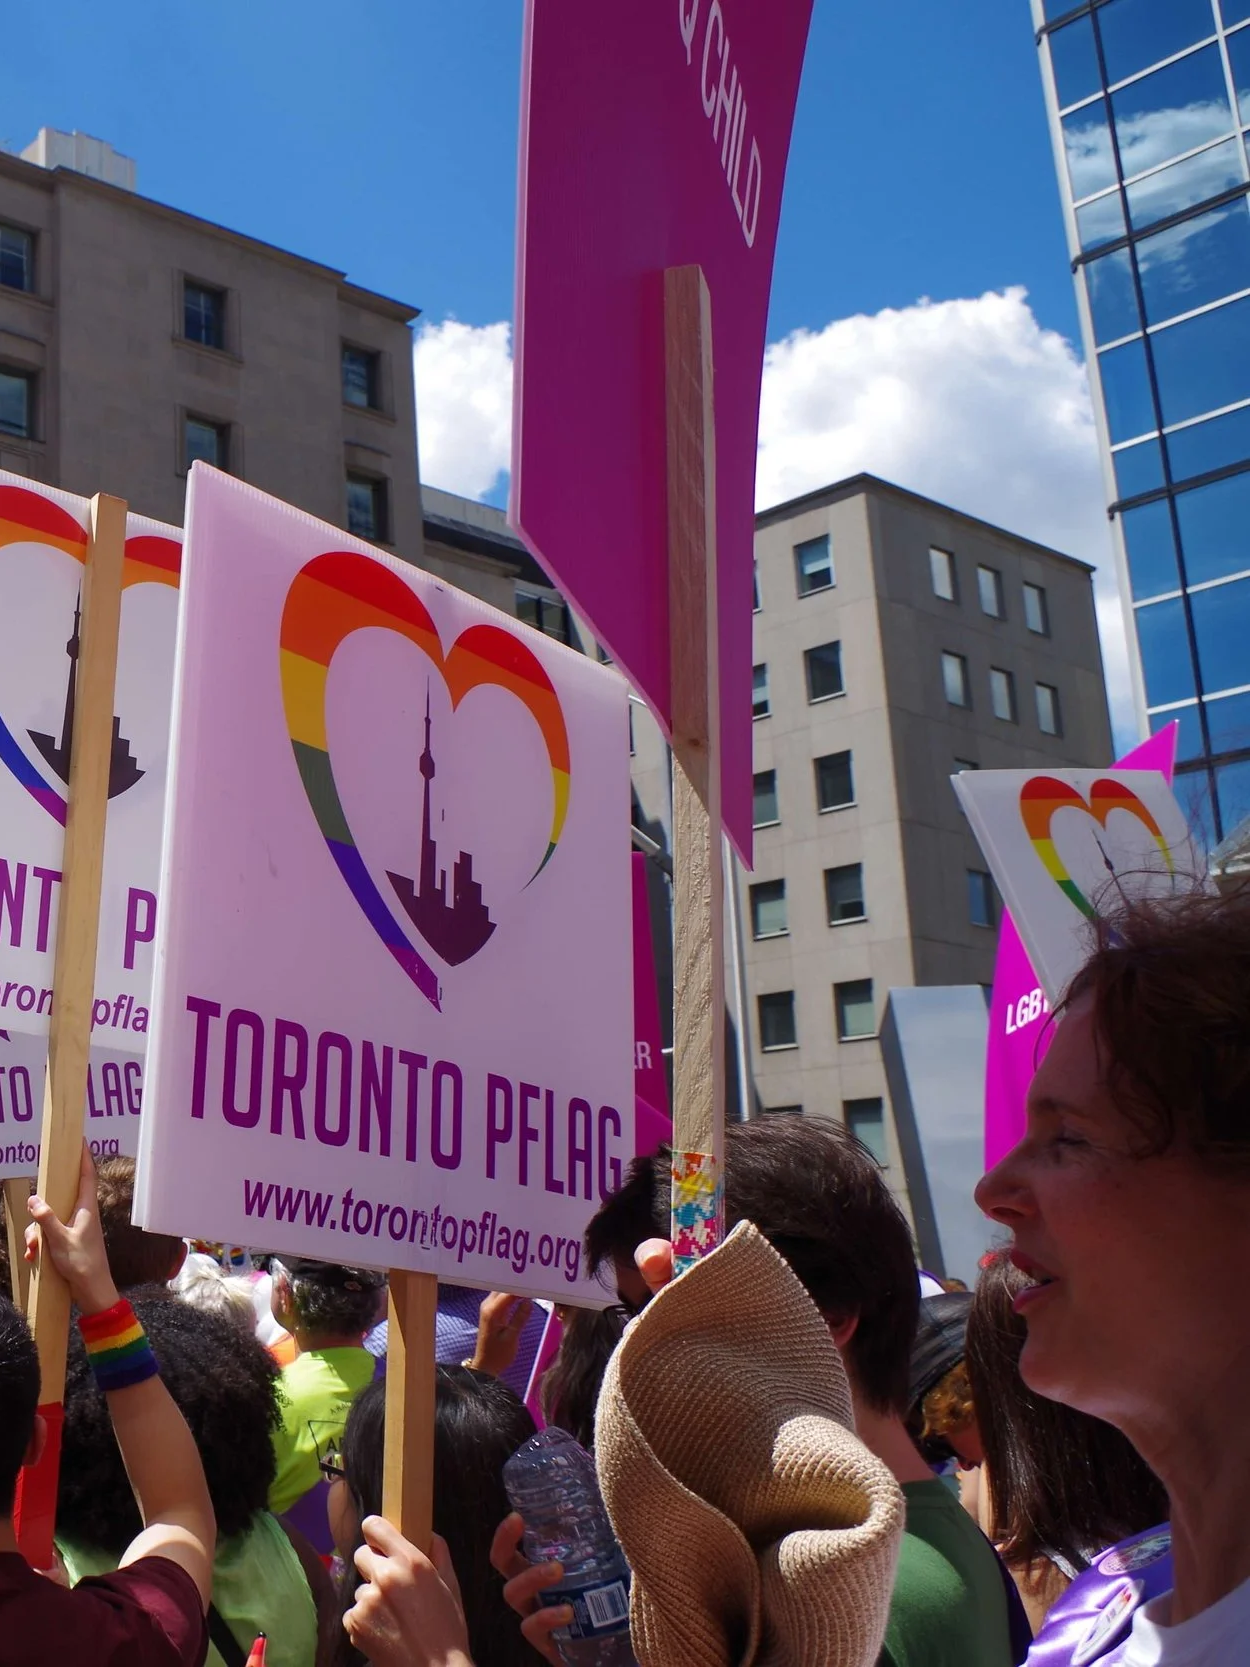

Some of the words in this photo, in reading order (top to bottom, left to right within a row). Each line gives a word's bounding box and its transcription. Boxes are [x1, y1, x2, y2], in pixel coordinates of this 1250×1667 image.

[701, 0, 761, 249] CHILD
[86, 1060, 144, 1119] LAG
[186, 995, 463, 1171] TORONTO
[486, 1072, 622, 1202] PFLAG
[243, 1178, 582, 1283] www.torontopflag.org
